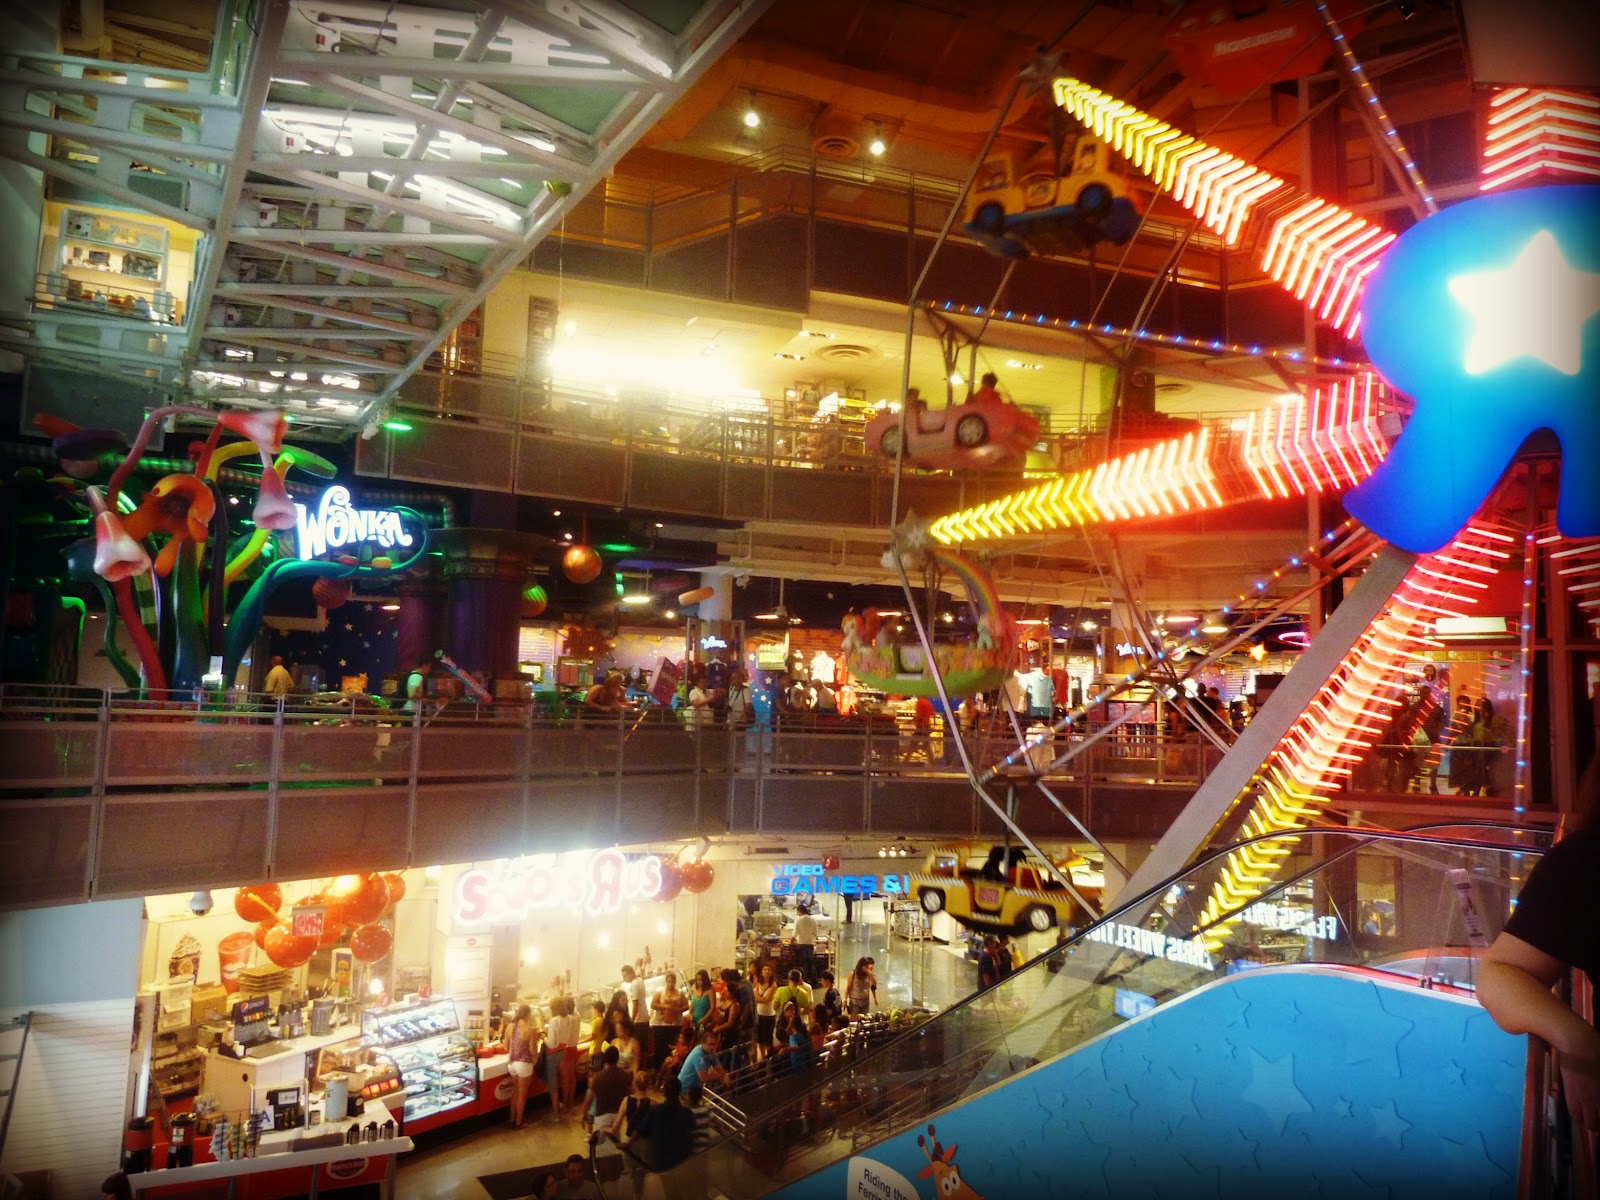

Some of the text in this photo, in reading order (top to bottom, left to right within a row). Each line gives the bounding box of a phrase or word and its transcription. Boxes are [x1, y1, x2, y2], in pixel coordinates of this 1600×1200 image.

[772, 864, 824, 876] VIDEO
[771, 875, 877, 895] GAMES
[864, 1168, 891, 1198] Riding
